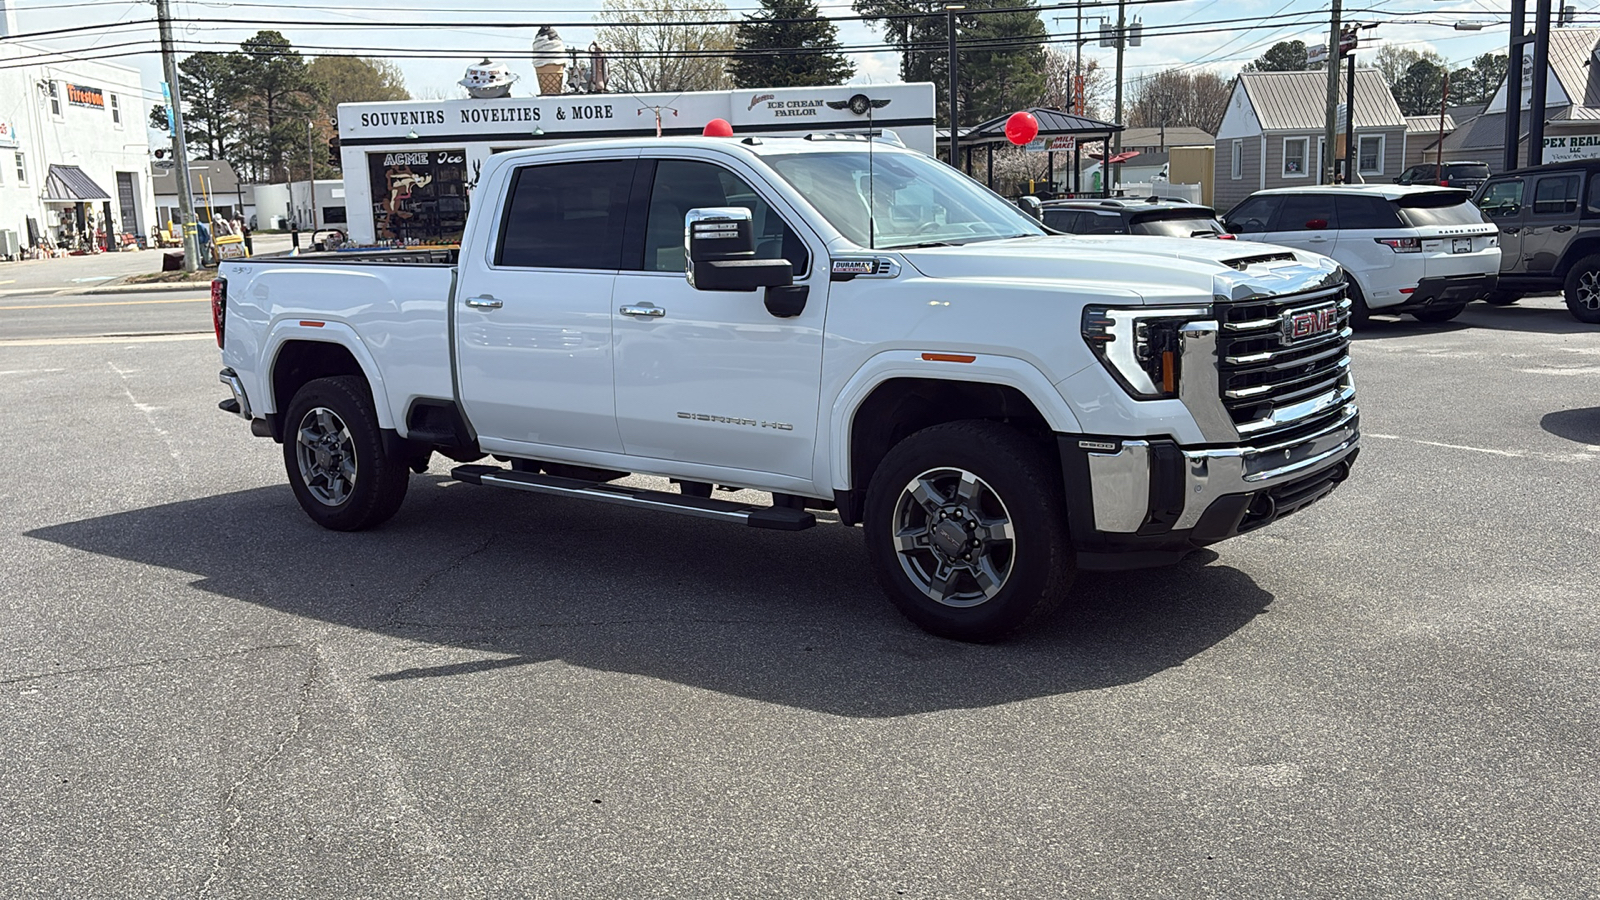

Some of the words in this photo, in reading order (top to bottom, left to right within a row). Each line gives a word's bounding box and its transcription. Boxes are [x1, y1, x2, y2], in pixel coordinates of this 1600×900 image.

[767, 101, 784, 109] ICE
[786, 100, 824, 108] CREAM
[361, 110, 445, 127] SOUVENIRS
[460, 107, 541, 123] NOVELTIES
[556, 106, 566, 121] &
[571, 104, 613, 120] MORE
[775, 108, 816, 117] PARLOR
[1543, 137, 1566, 148] PEX
[384, 153, 429, 166] ACME
[437, 152, 464, 164] Ice
[1292, 307, 1337, 338] GMC
[677, 411, 757, 427] SIERRA
[761, 421, 793, 431] HD
